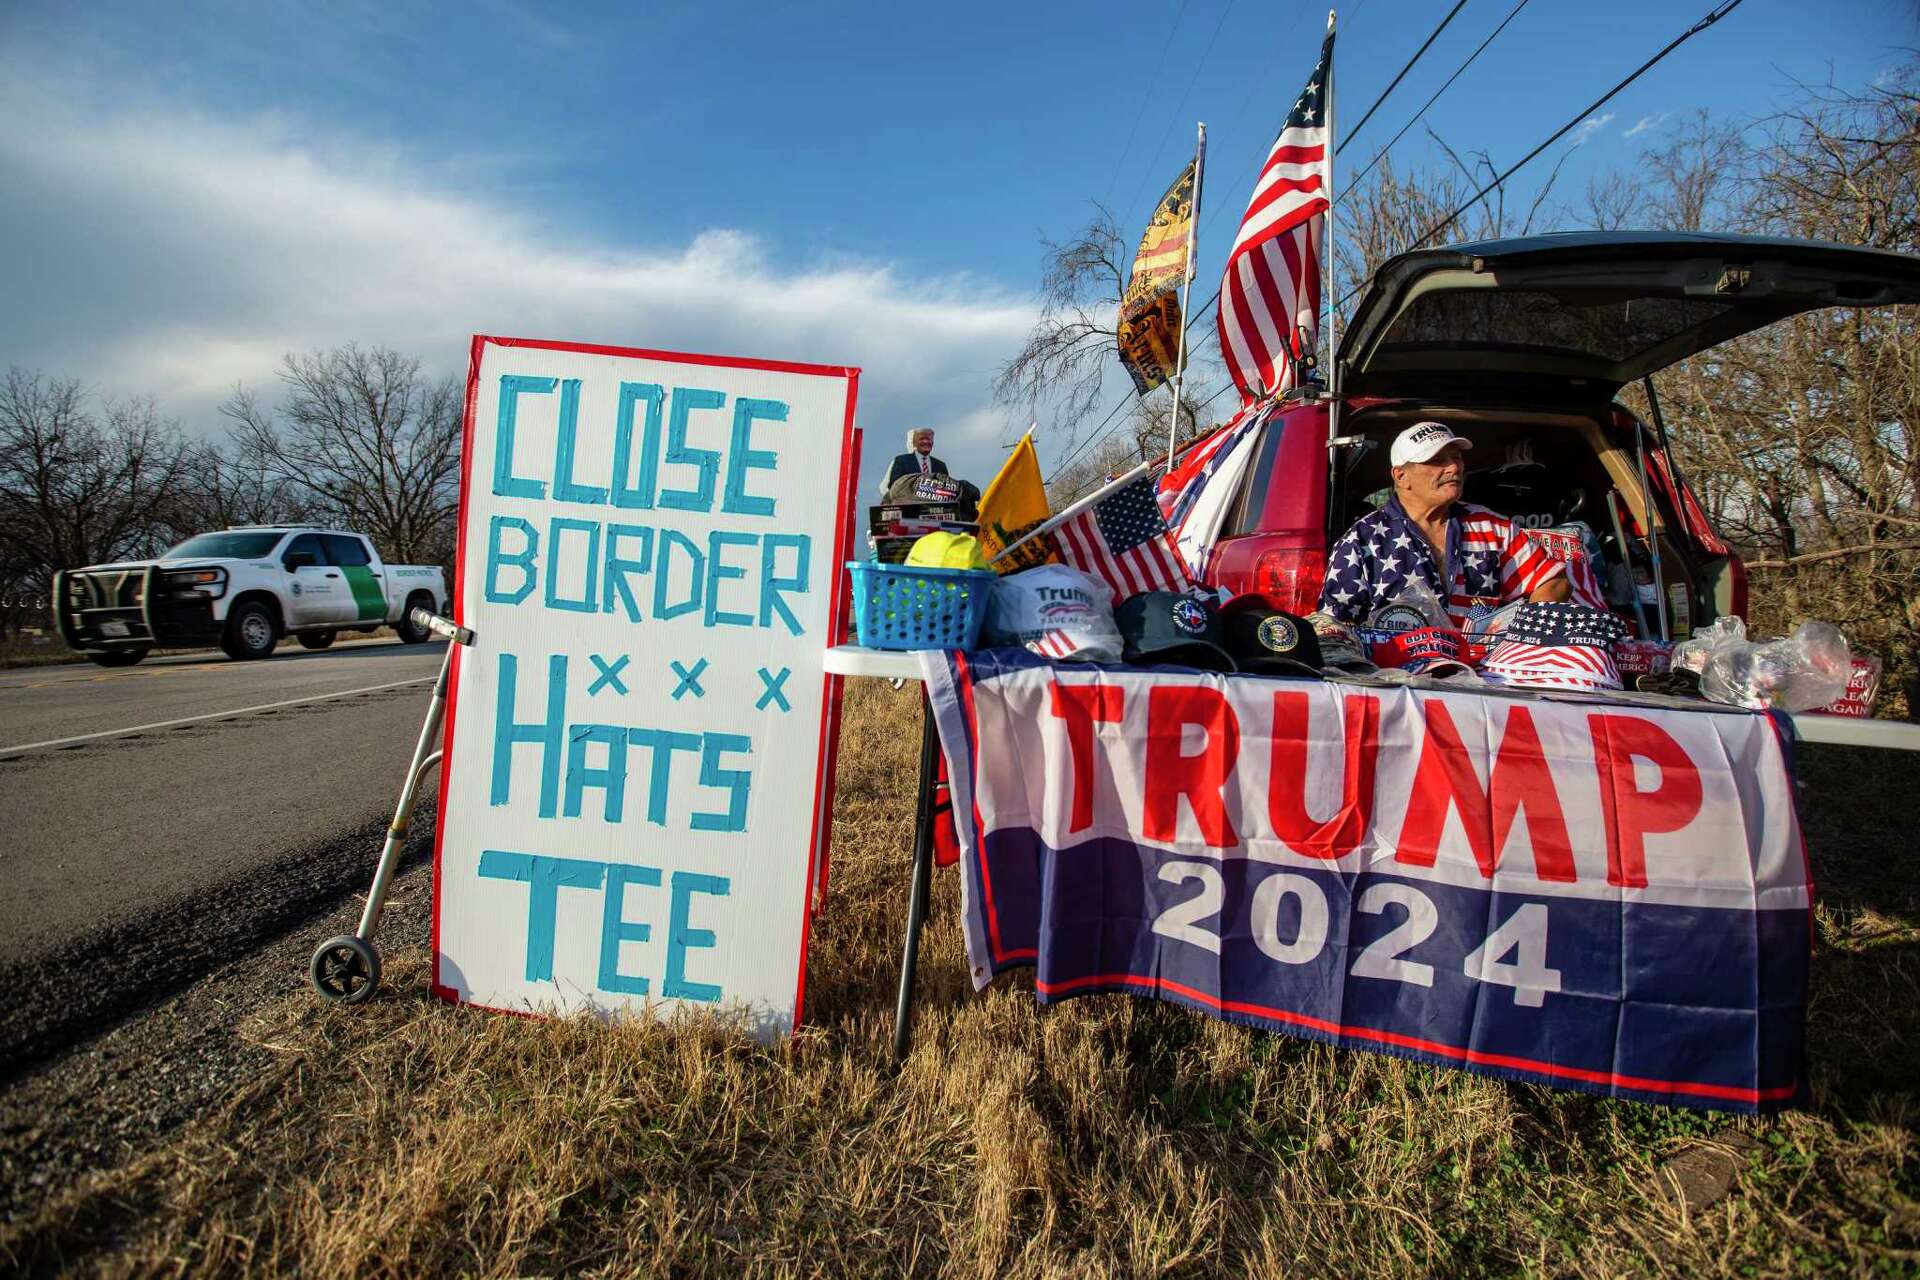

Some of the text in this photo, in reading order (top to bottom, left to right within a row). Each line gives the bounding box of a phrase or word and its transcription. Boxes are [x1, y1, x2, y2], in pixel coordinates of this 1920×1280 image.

[492, 374, 790, 517] CLOSE
[919, 477, 958, 492] LET'S GO
[486, 515, 811, 637] BORDER
[1568, 637, 1607, 647] TRUMP
[1616, 652, 1642, 661] KEEP
[1616, 663, 1649, 672] MERICA
[490, 653, 754, 834] HATS
[1048, 679, 1704, 889] TRUMP
[478, 850, 731, 1002] TEE
[1151, 859, 1562, 1008] 2024
